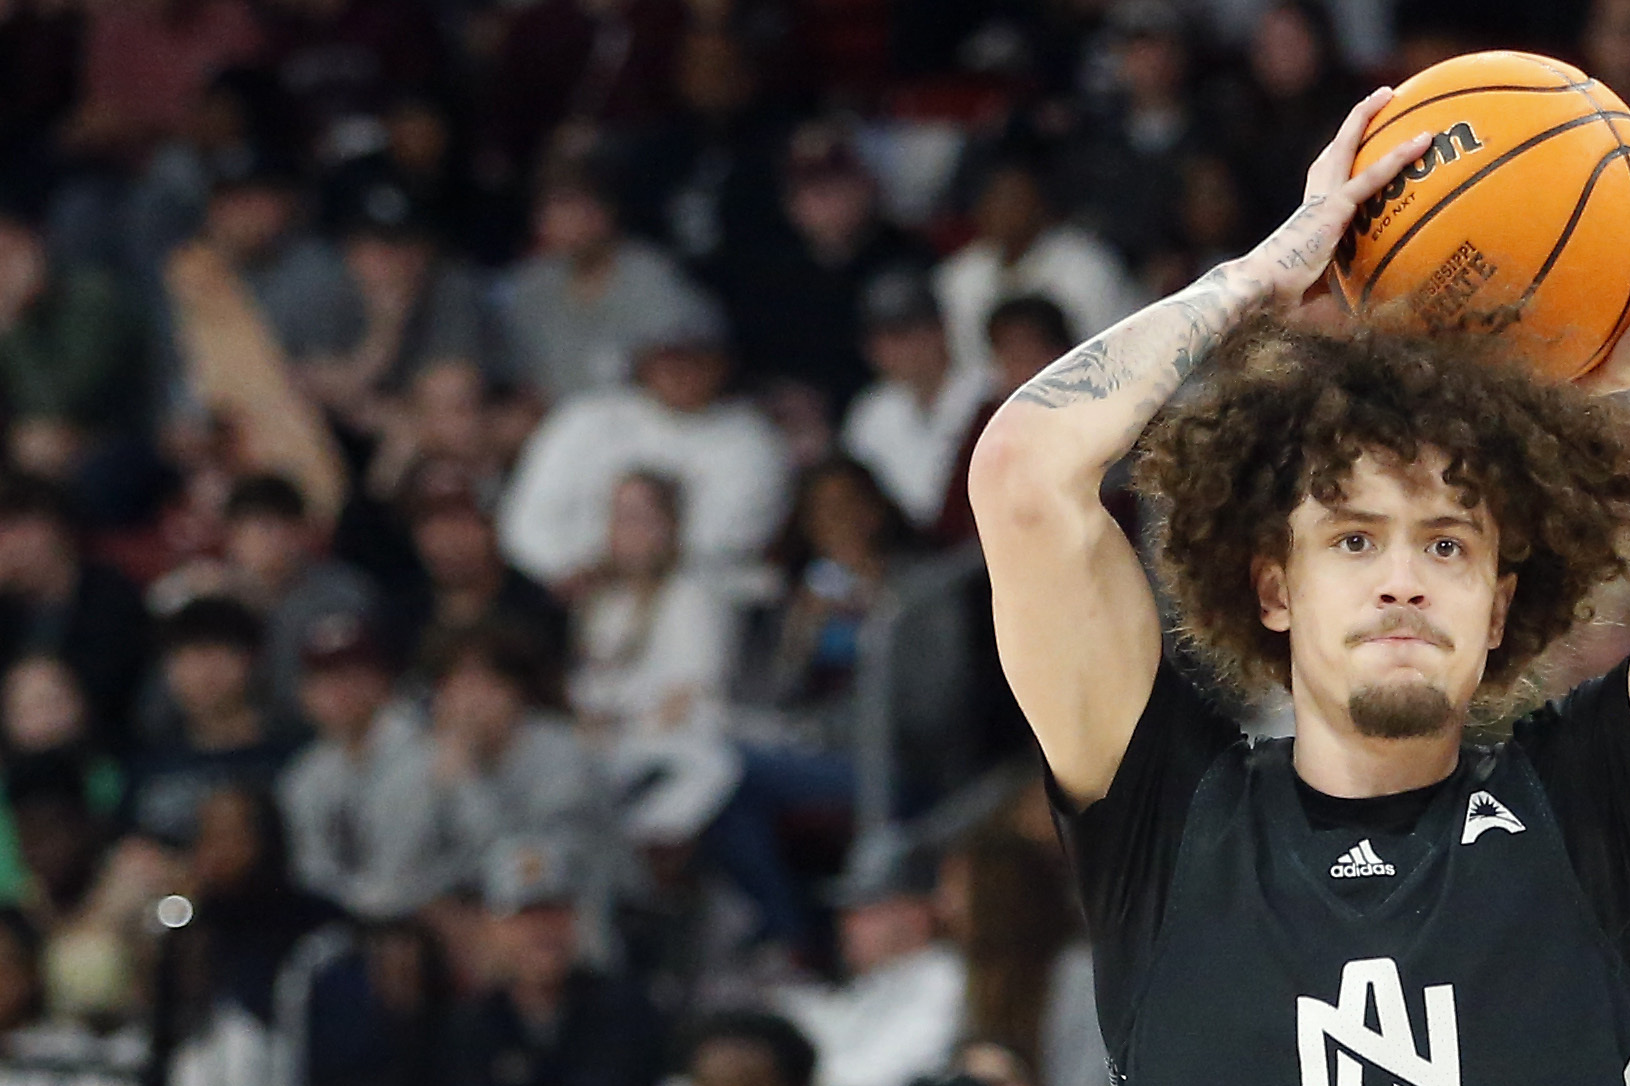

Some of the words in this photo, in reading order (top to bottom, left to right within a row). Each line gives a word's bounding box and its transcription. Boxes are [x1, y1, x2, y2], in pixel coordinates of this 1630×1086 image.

[1371, 216, 1392, 242] EVO
[1392, 192, 1417, 216] NXT
[1330, 862, 1397, 878] adidas
